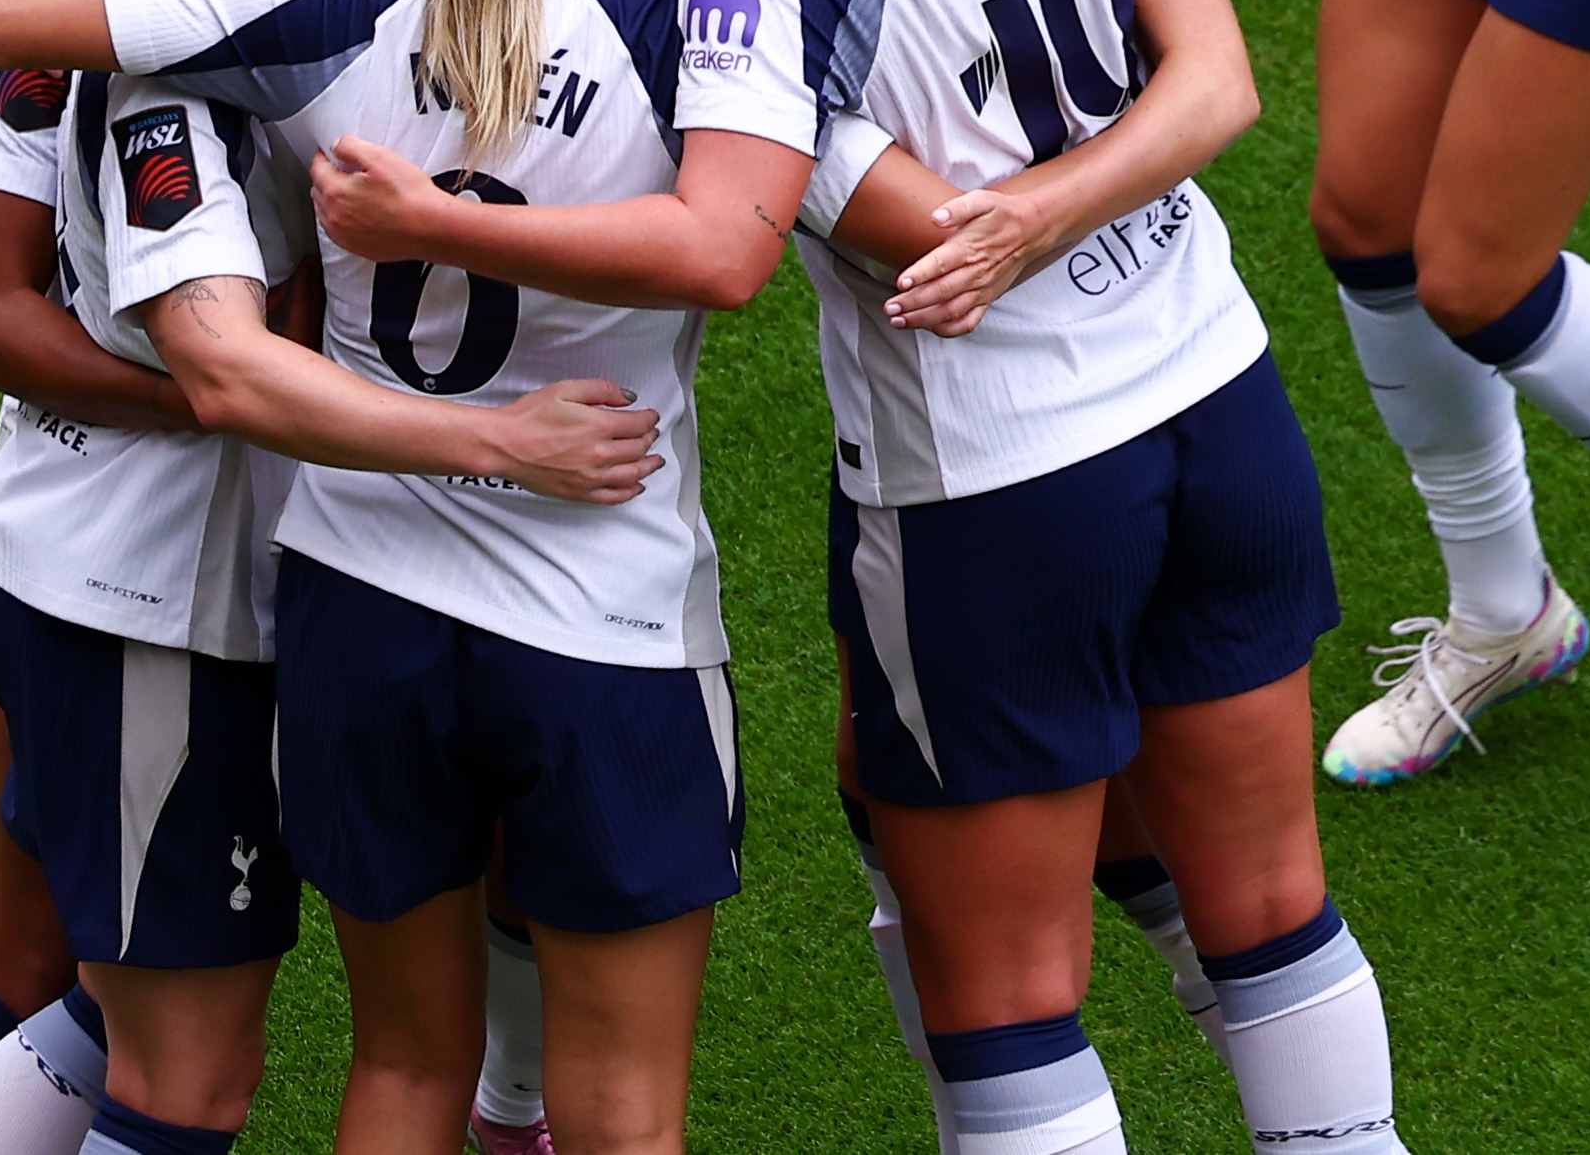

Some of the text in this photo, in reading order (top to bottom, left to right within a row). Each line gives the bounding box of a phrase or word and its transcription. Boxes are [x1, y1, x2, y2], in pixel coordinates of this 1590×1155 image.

[410, 48, 600, 138] NÉN
[137, 112, 179, 130] BARCLAYS
[124, 123, 184, 161] WSL
[35, 411, 88, 456] FACE.
